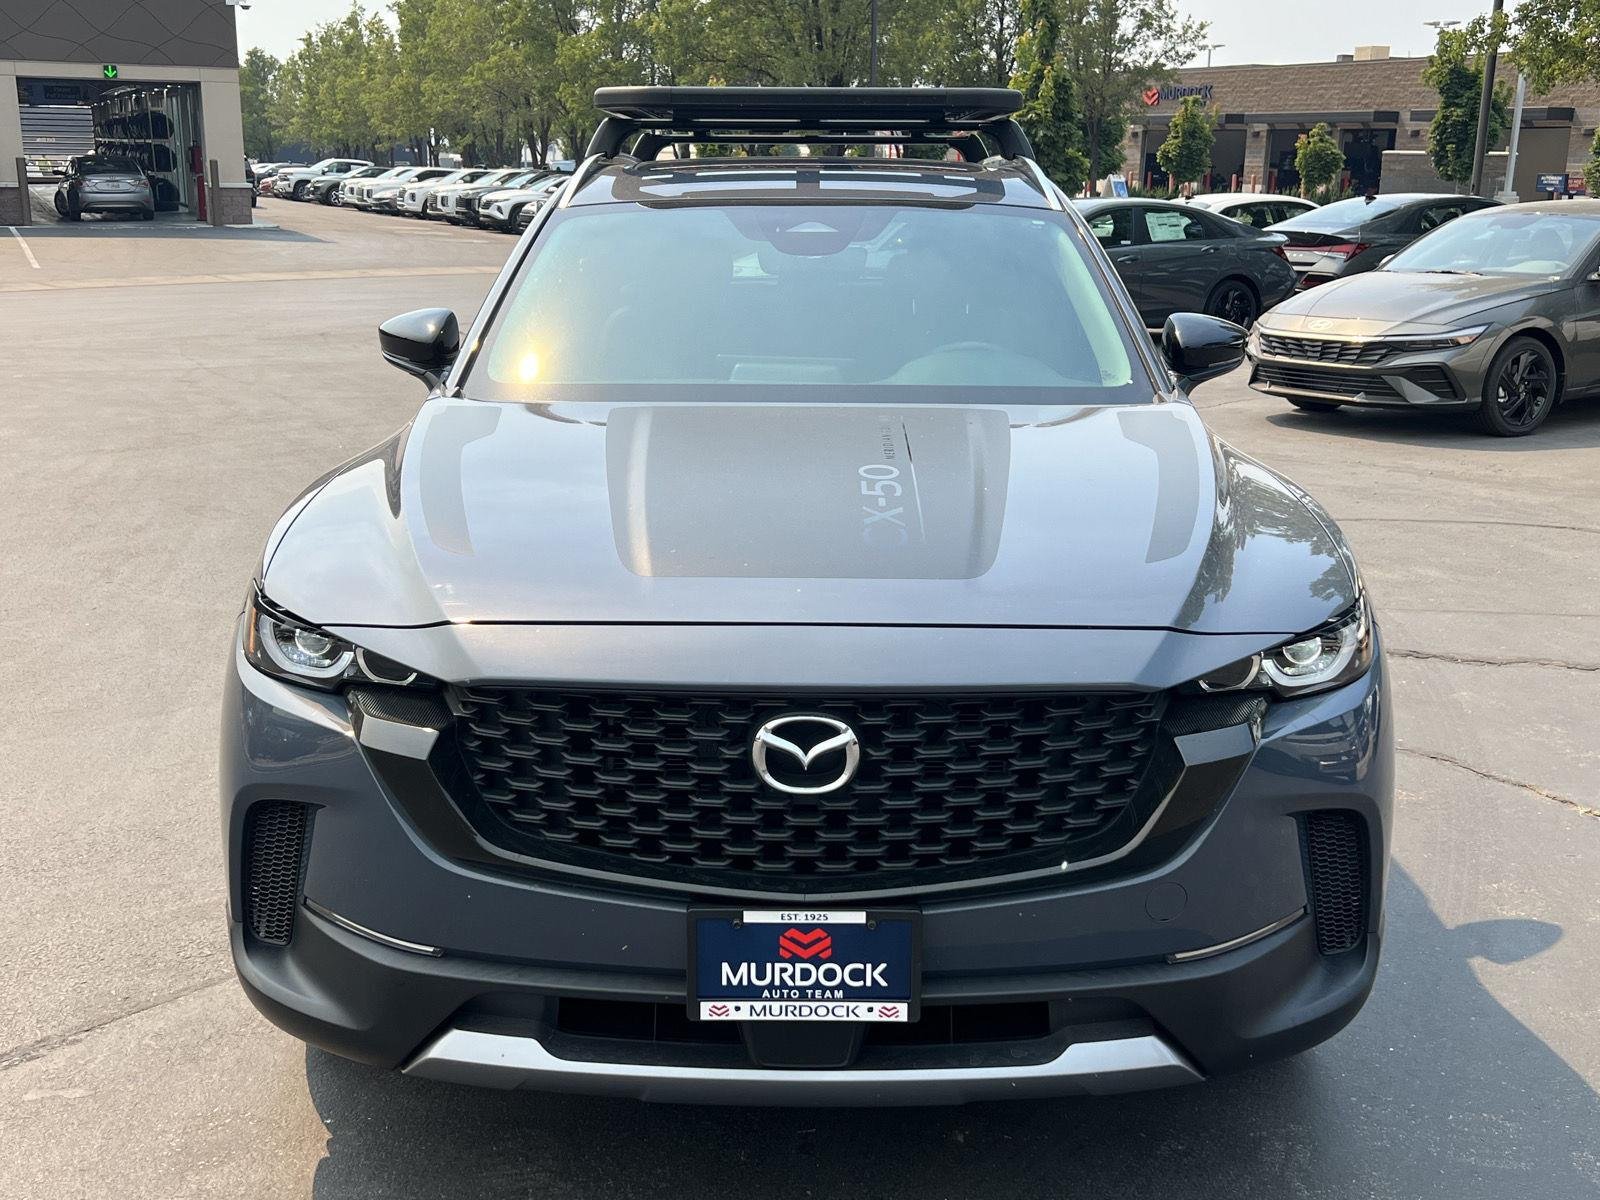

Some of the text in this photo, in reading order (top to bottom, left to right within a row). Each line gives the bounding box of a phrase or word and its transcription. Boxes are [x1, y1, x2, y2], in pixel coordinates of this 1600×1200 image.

[780, 913, 829, 921] EST. 1925
[721, 961, 888, 987] MURDOCK
[762, 989, 844, 999] AUTO TEAM
[749, 1004, 861, 1018] MURDOCK
